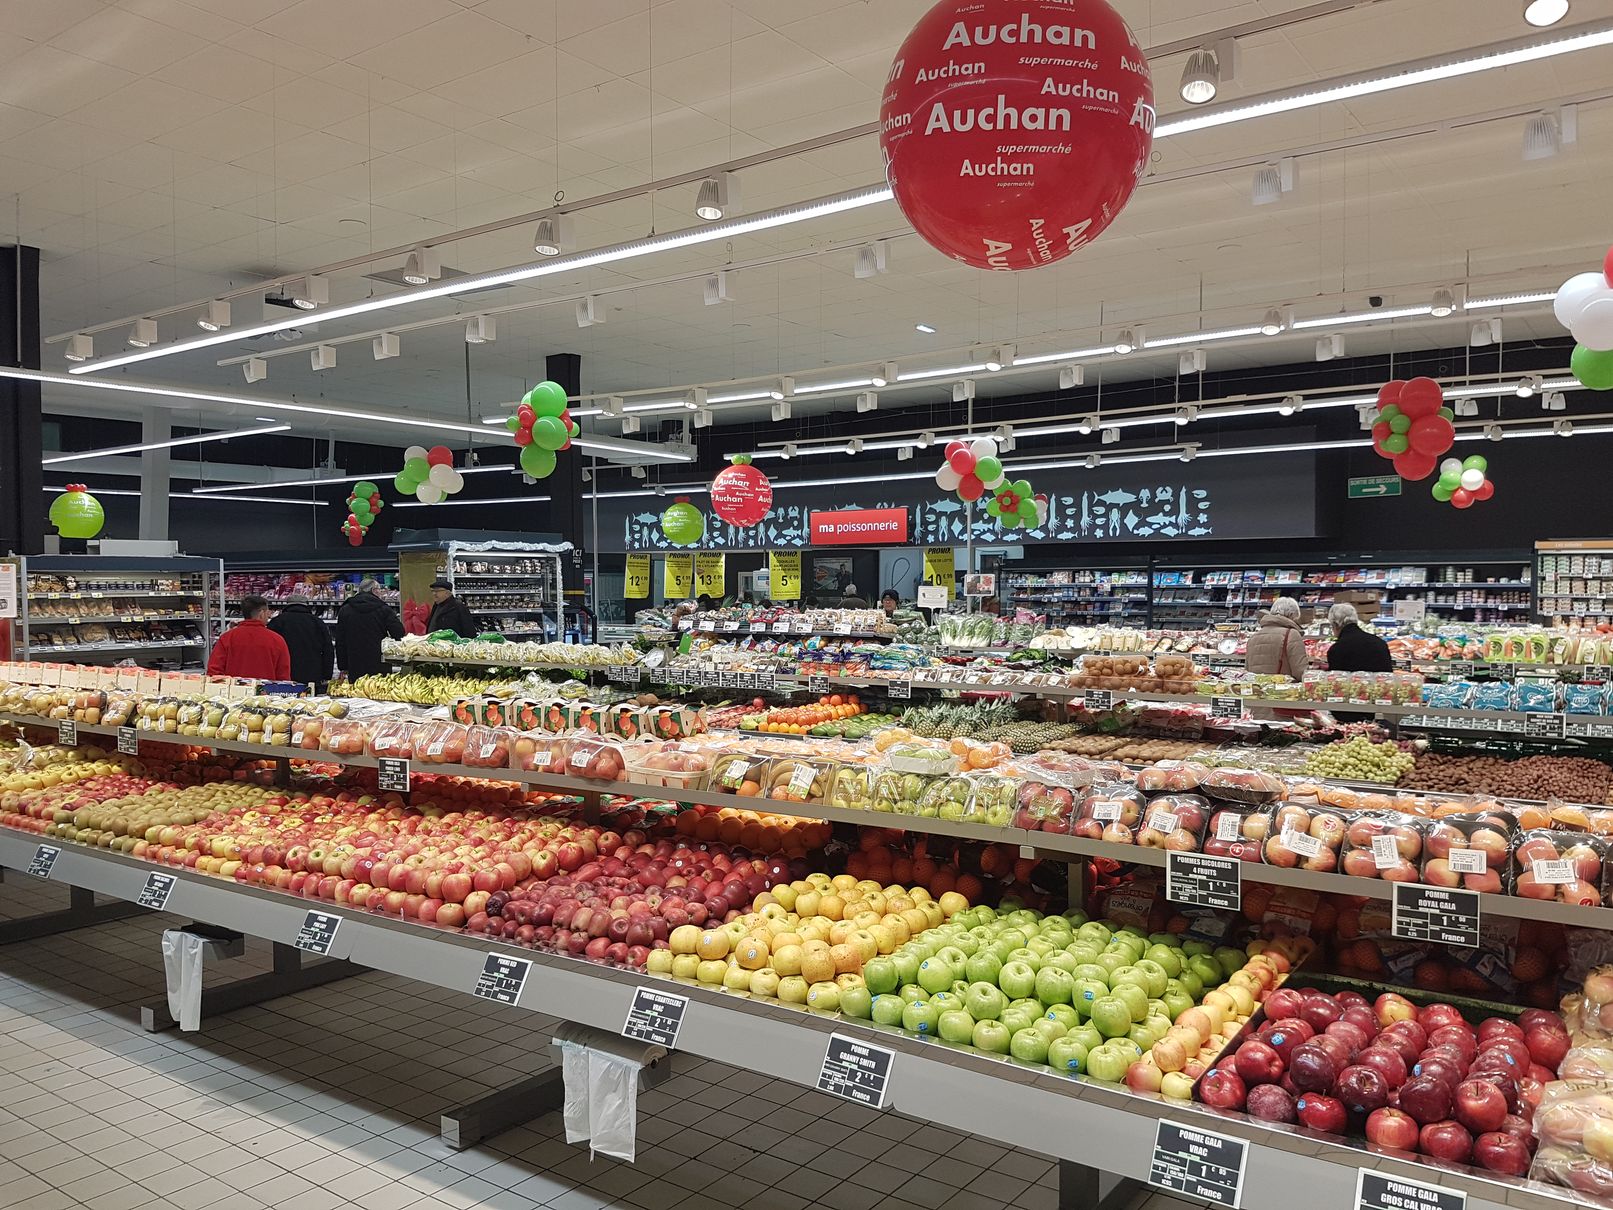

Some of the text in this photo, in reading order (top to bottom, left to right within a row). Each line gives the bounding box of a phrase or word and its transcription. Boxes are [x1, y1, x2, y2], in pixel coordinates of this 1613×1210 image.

[942, 13, 1096, 50] Auchan
[1018, 55, 1098, 71] supermarché
[914, 59, 985, 84] Auchan
[1040, 77, 1119, 103] Auchan
[924, 95, 1071, 136] Auchan
[996, 142, 1072, 155] supermarché
[960, 157, 1034, 177] Auchan
[1029, 218, 1053, 262] Auchan
[718, 478, 750, 487] Auchan
[715, 494, 743, 503] Auchan
[819, 520, 898, 534] ma poissonnerie
[629, 576, 640, 586] 12
[676, 576, 682, 586] 5
[700, 575, 712, 585] 13
[782, 576, 788, 586] 5
[928, 574, 942, 586] 10
[1177, 856, 1232, 869] POMMES BICOLORES
[1198, 868, 1217, 876] FRUITS
[1208, 882, 1213, 890] 1
[1425, 890, 1449, 899] POMME
[1208, 897, 1228, 906] France
[1418, 899, 1456, 910] ROYAL GALA
[1442, 916, 1447, 925] 1
[655, 1018, 660, 1027] 2
[851, 1044, 870, 1056] POMME
[840, 1052, 876, 1069] GRANNY SMITH
[855, 1072, 862, 1082] 2
[1179, 1129, 1222, 1148] POMME GALA
[1189, 1144, 1208, 1157] VRAC
[1201, 1165, 1207, 1177] 1
[1197, 1185, 1222, 1200] France
[1387, 1182, 1438, 1202] POMME GALA
[1381, 1193, 1403, 1206] GROS
[1404, 1199, 1420, 1210] CAL
